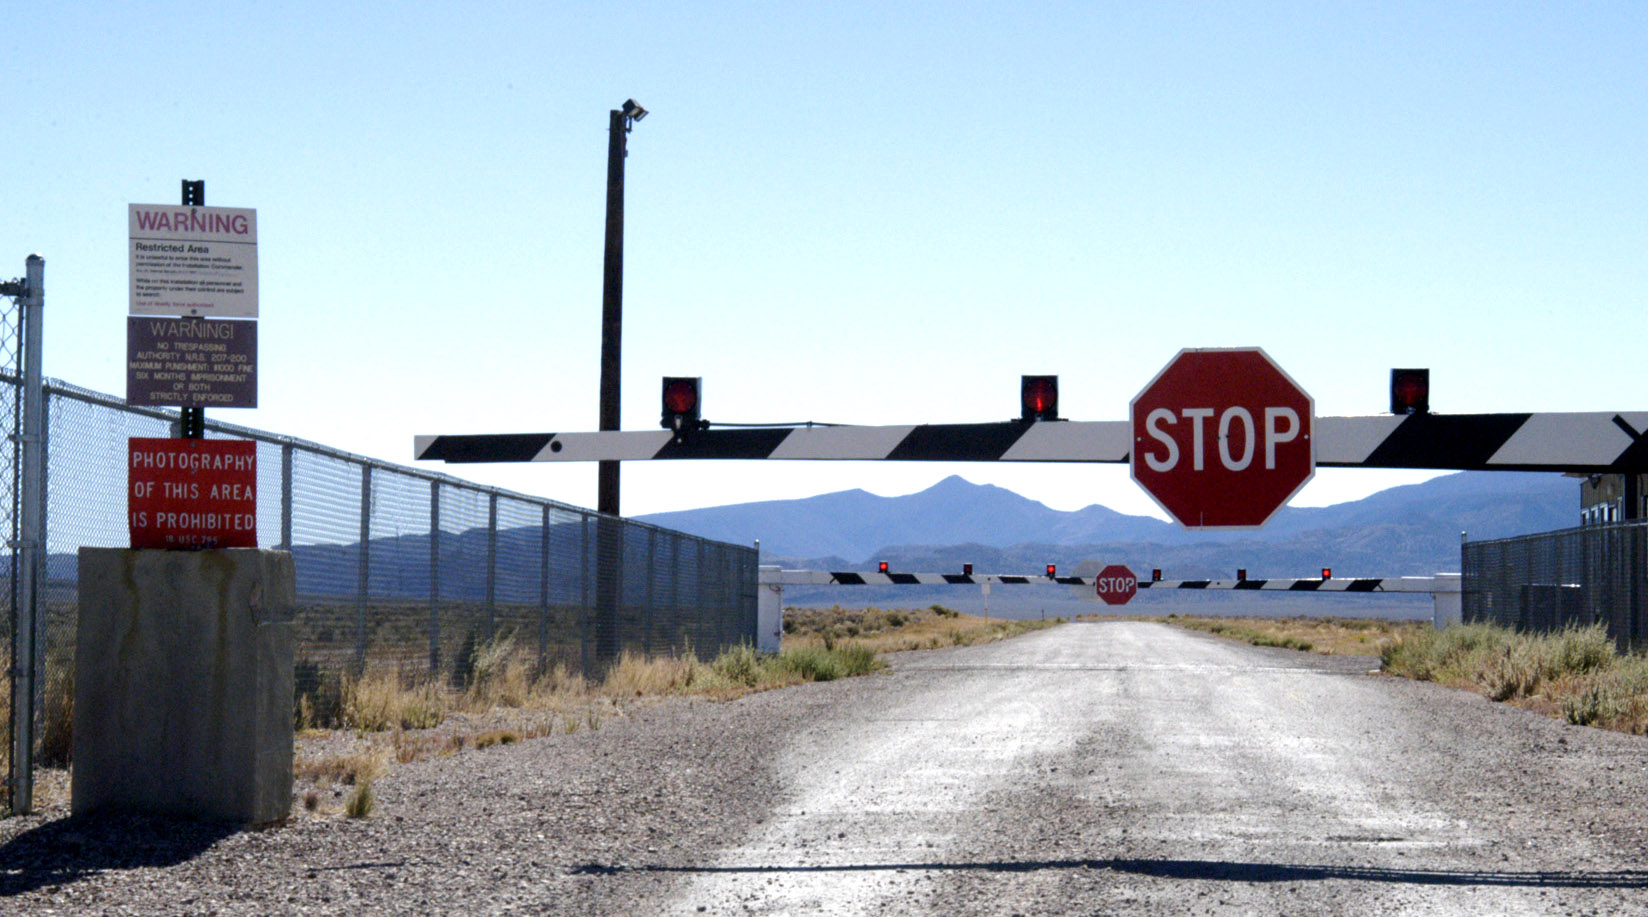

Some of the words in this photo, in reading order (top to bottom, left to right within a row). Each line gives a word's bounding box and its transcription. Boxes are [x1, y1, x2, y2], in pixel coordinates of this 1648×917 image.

[136, 211, 248, 234] WARNING
[135, 243, 184, 252] Restricted
[187, 245, 209, 254] Area
[151, 321, 234, 339] WARNING!
[174, 342, 227, 351] TRESPASSING
[137, 352, 180, 360] AUTHORITY
[130, 362, 162, 370] MAXIMUM
[135, 372, 148, 380] SIX
[154, 373, 186, 381] MONTHS
[190, 374, 247, 382] IMPRISONMENT
[173, 382, 184, 390] OR
[188, 383, 211, 391] BOTH
[150, 392, 188, 401] STRICTLY
[192, 394, 234, 402] ENFORCED
[1144, 406, 1300, 472] STOP
[133, 452, 254, 471] PHOTOGRAPHY
[134, 481, 155, 498] OF
[164, 482, 199, 499] THIS
[210, 484, 253, 500] AREA
[133, 512, 148, 527] IS
[157, 512, 254, 530] PROHIBITED
[1098, 576, 1135, 593] STOP
